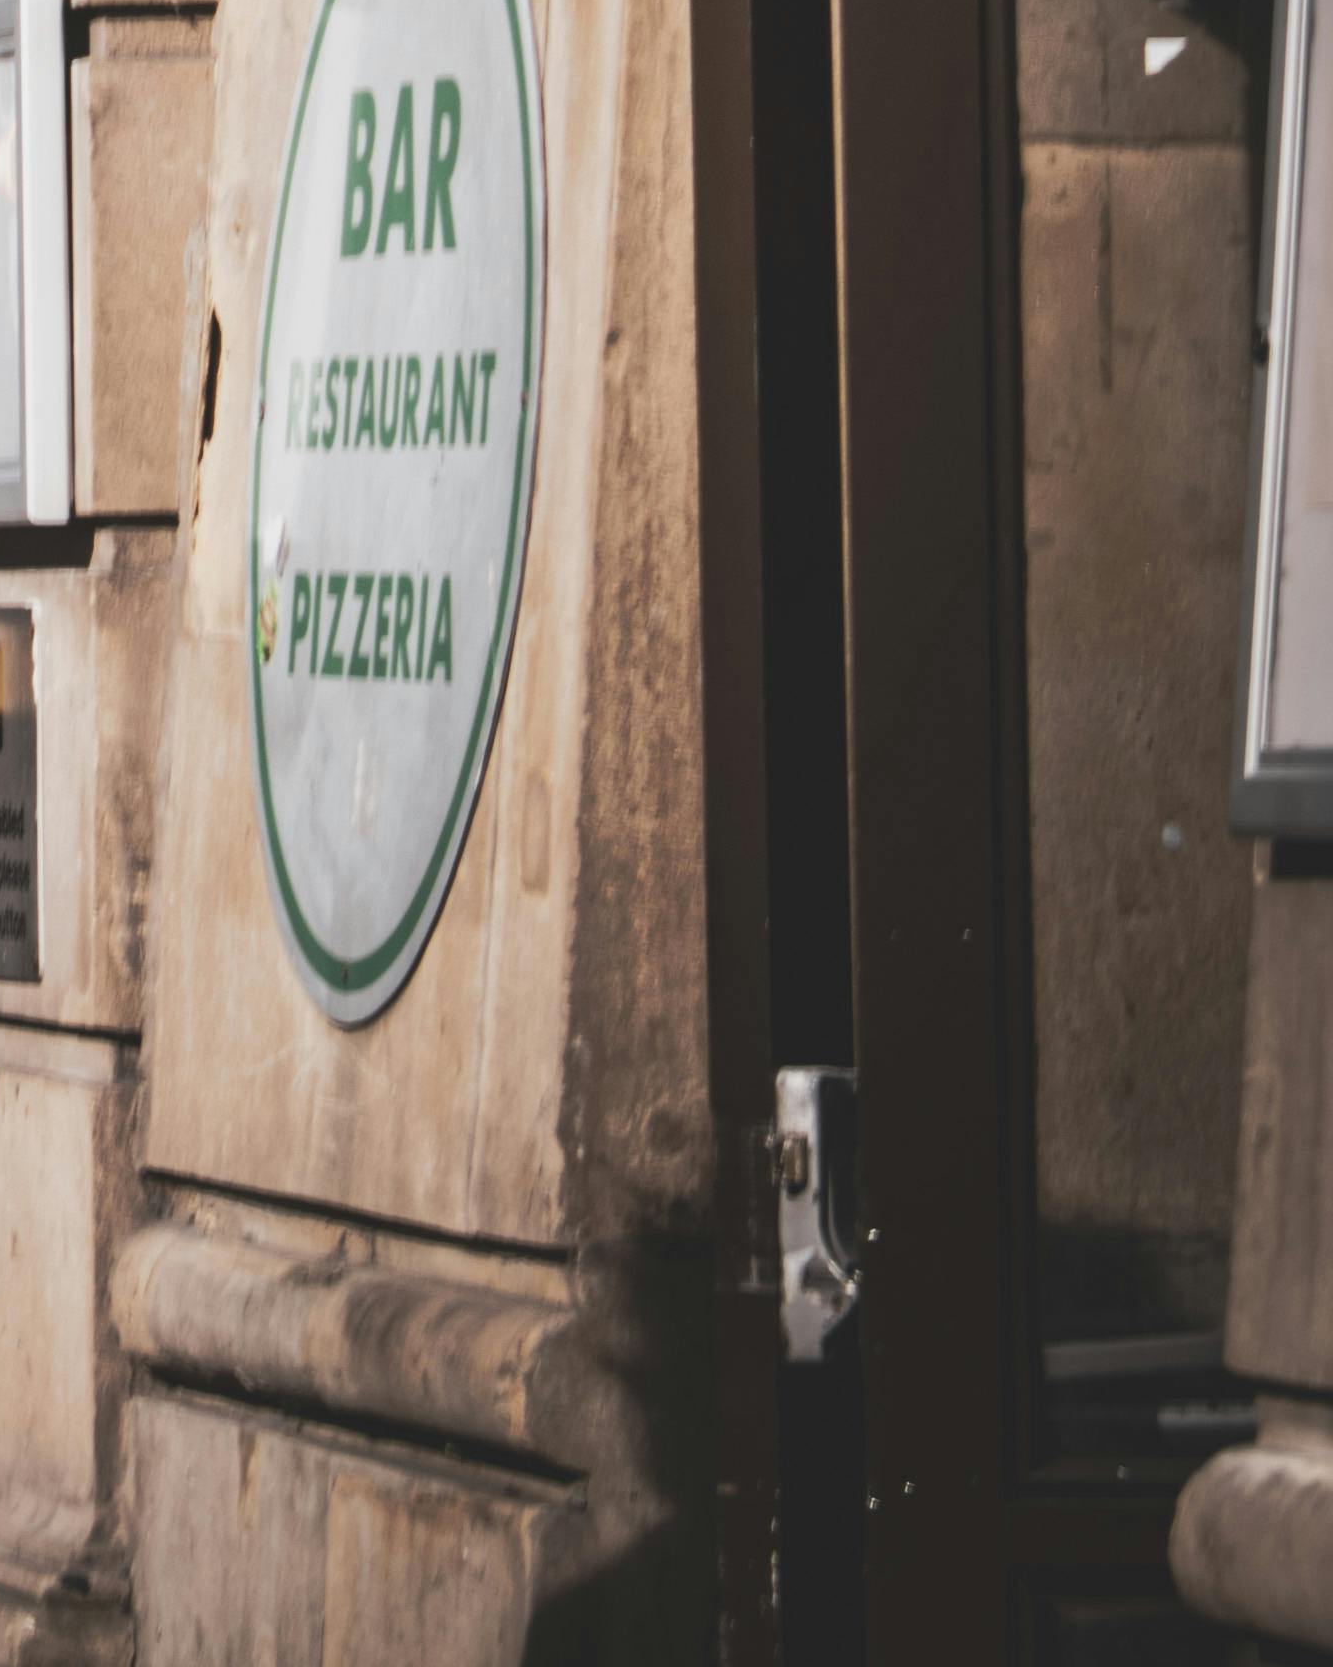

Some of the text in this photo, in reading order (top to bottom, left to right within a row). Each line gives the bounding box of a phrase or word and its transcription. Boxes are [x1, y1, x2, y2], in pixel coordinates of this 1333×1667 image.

[339, 76, 463, 261] BAR
[285, 350, 498, 455] RESTAURANT
[286, 569, 454, 686] PIZZERIA
